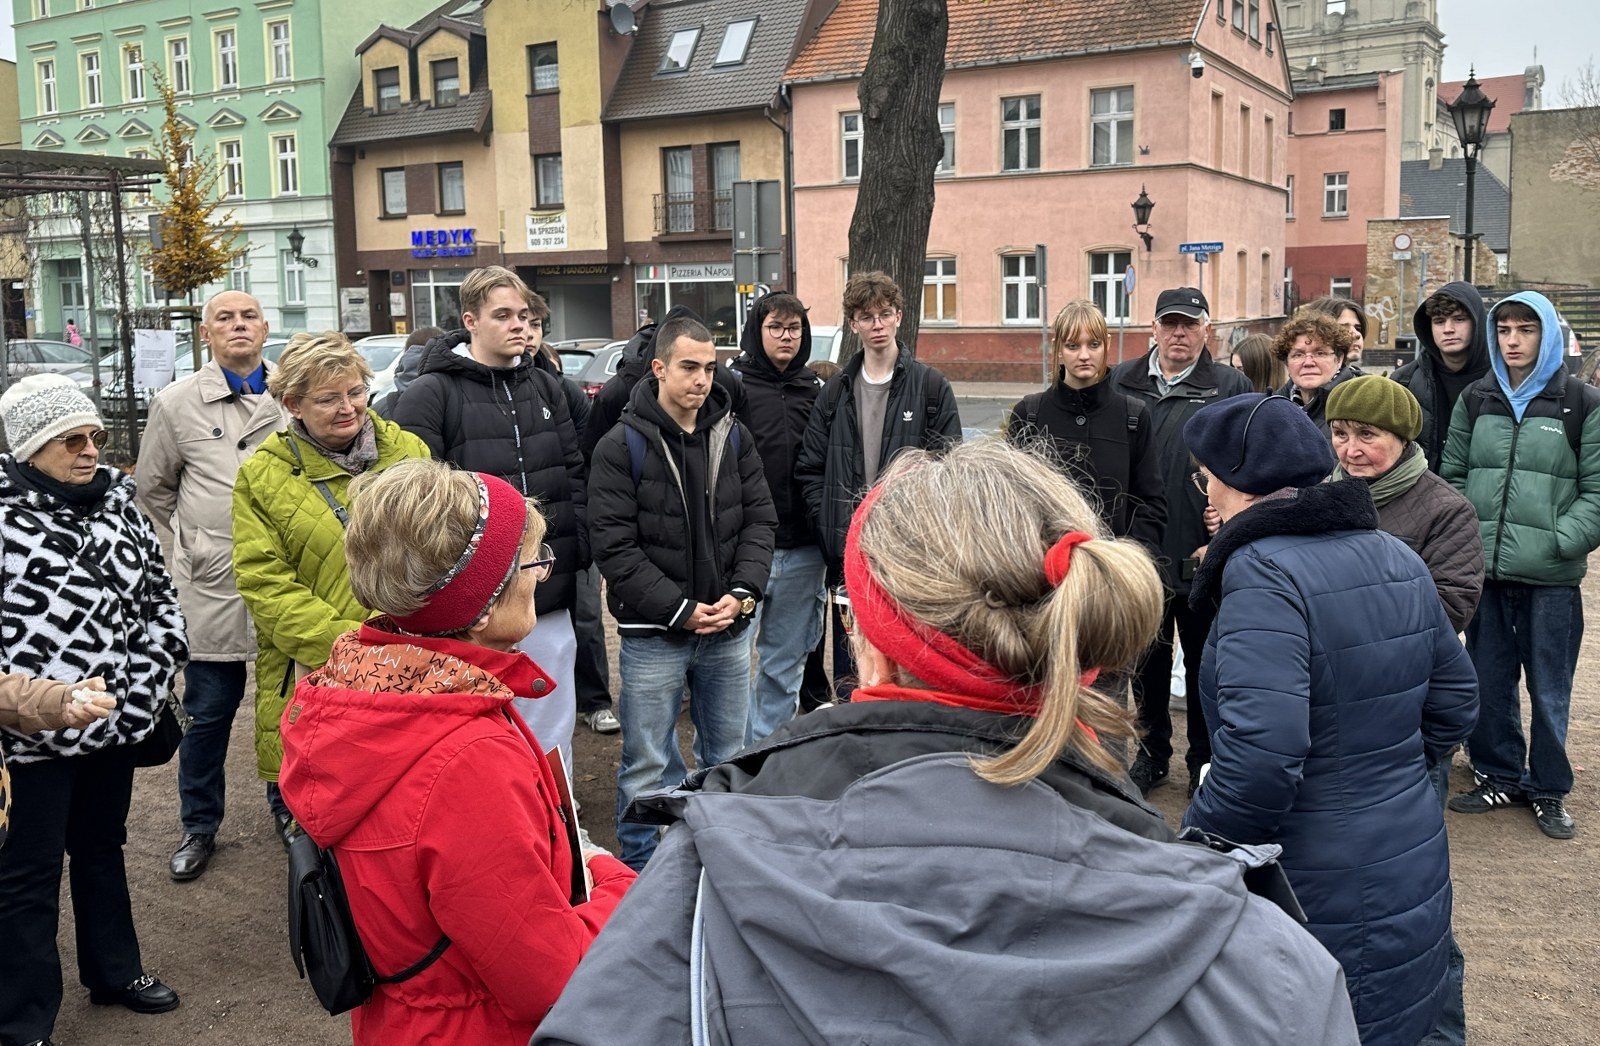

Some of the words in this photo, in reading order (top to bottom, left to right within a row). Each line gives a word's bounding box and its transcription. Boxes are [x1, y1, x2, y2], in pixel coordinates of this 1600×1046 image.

[538, 225, 565, 235] SPRZEDAŻ
[411, 229, 476, 246] MEDYK
[563, 264, 608, 273] HANDLOWY
